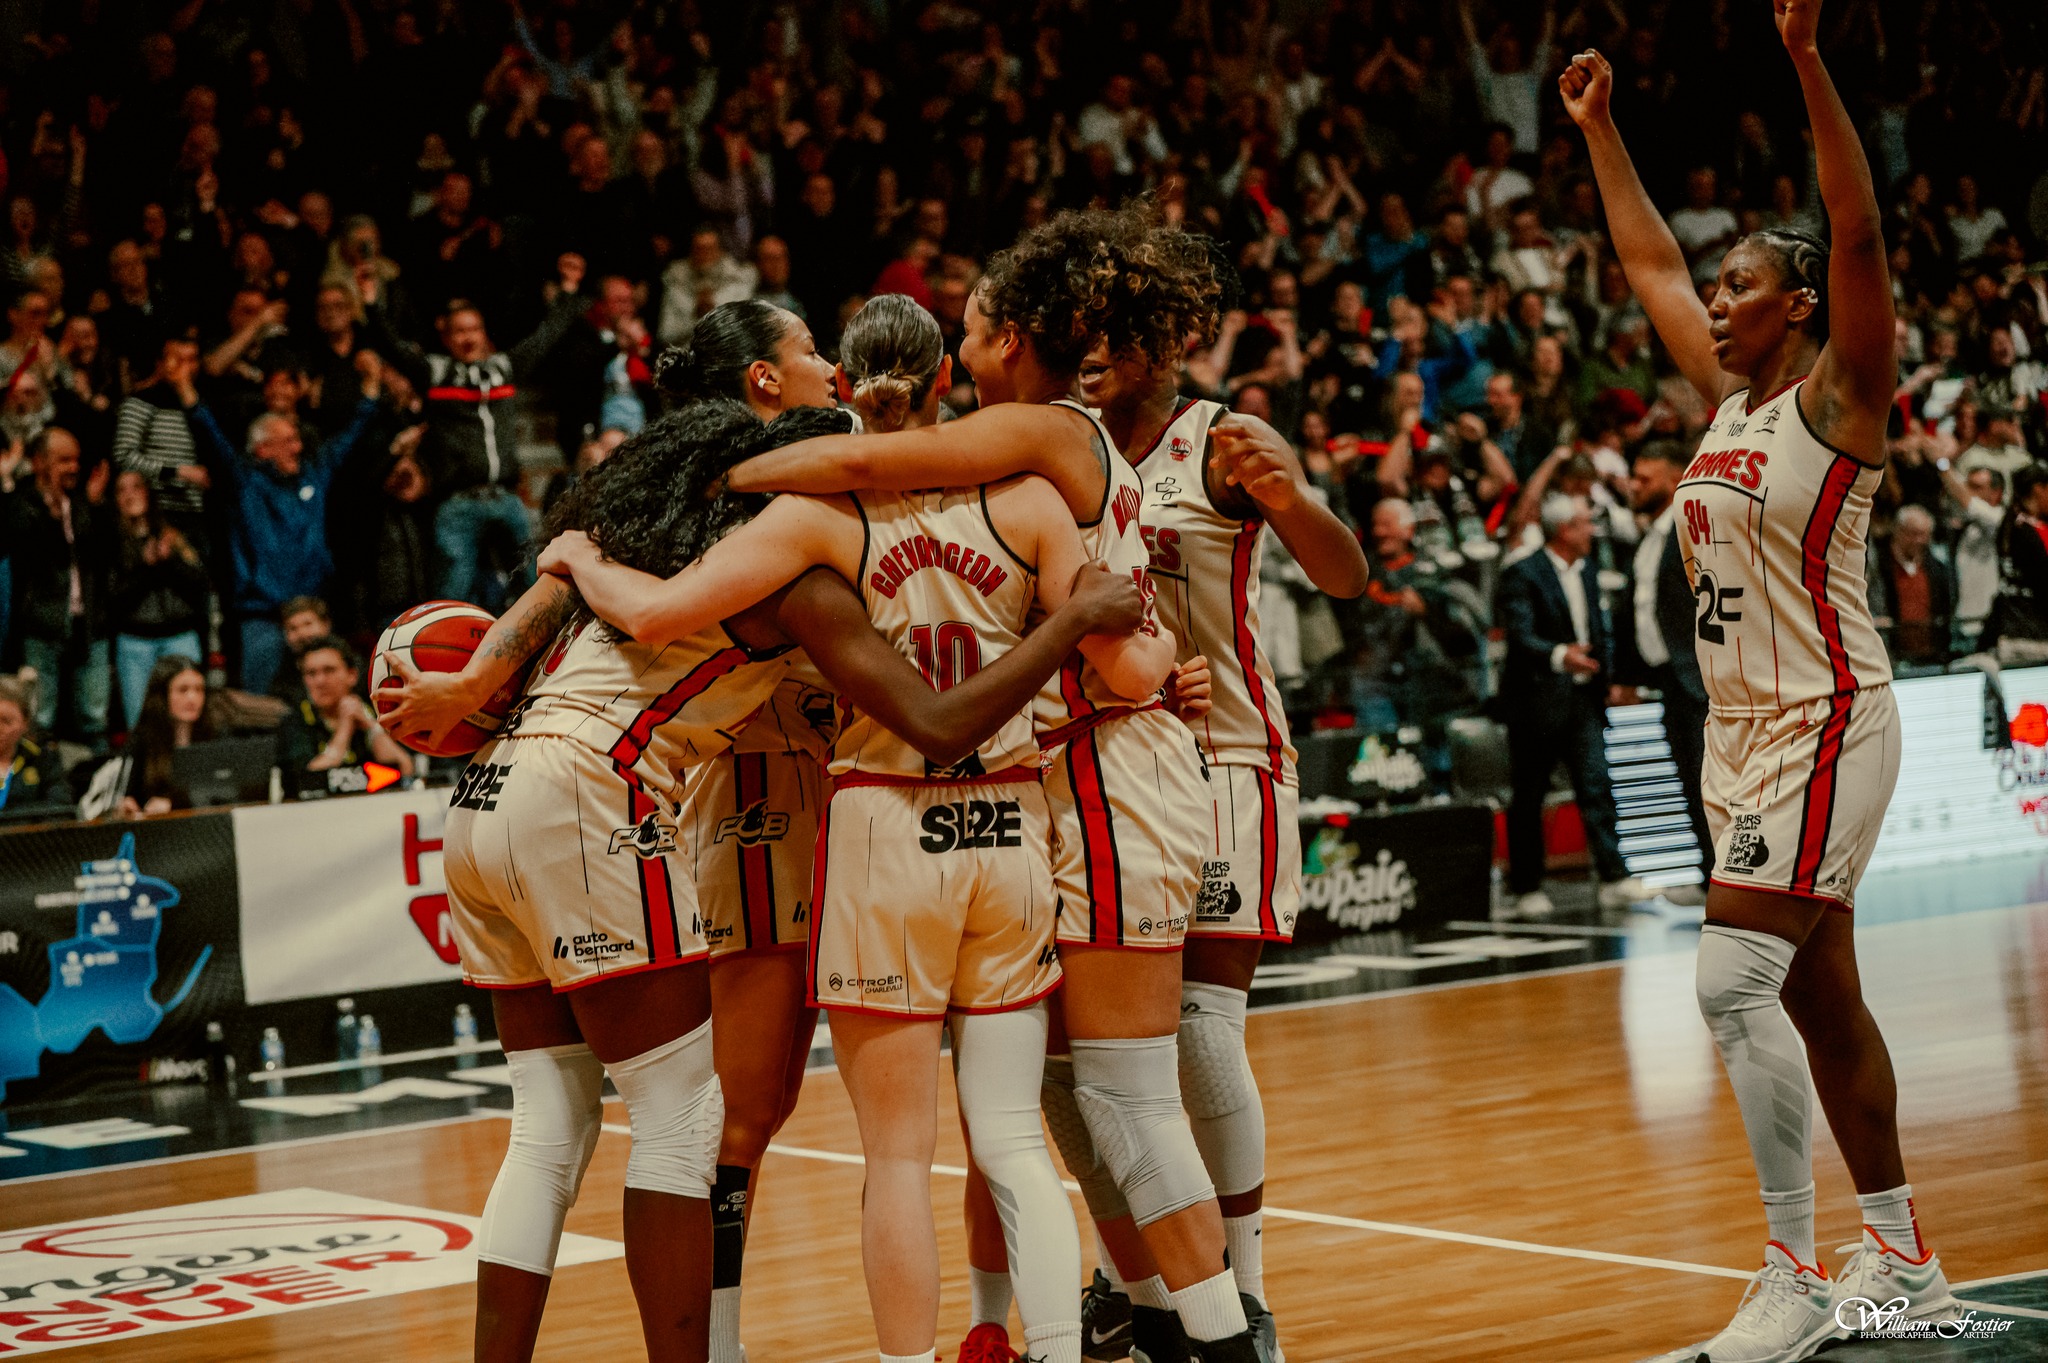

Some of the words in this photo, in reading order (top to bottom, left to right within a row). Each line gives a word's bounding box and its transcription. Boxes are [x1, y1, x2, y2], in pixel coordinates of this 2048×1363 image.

[1682, 448, 1768, 490] AMMES
[1683, 499, 1711, 545] 34
[910, 621, 982, 693] 10
[573, 932, 608, 945] auto
[704, 924, 733, 938] nard
[574, 939, 635, 957] bernard
[865, 984, 903, 994] CHARLEVILLE
